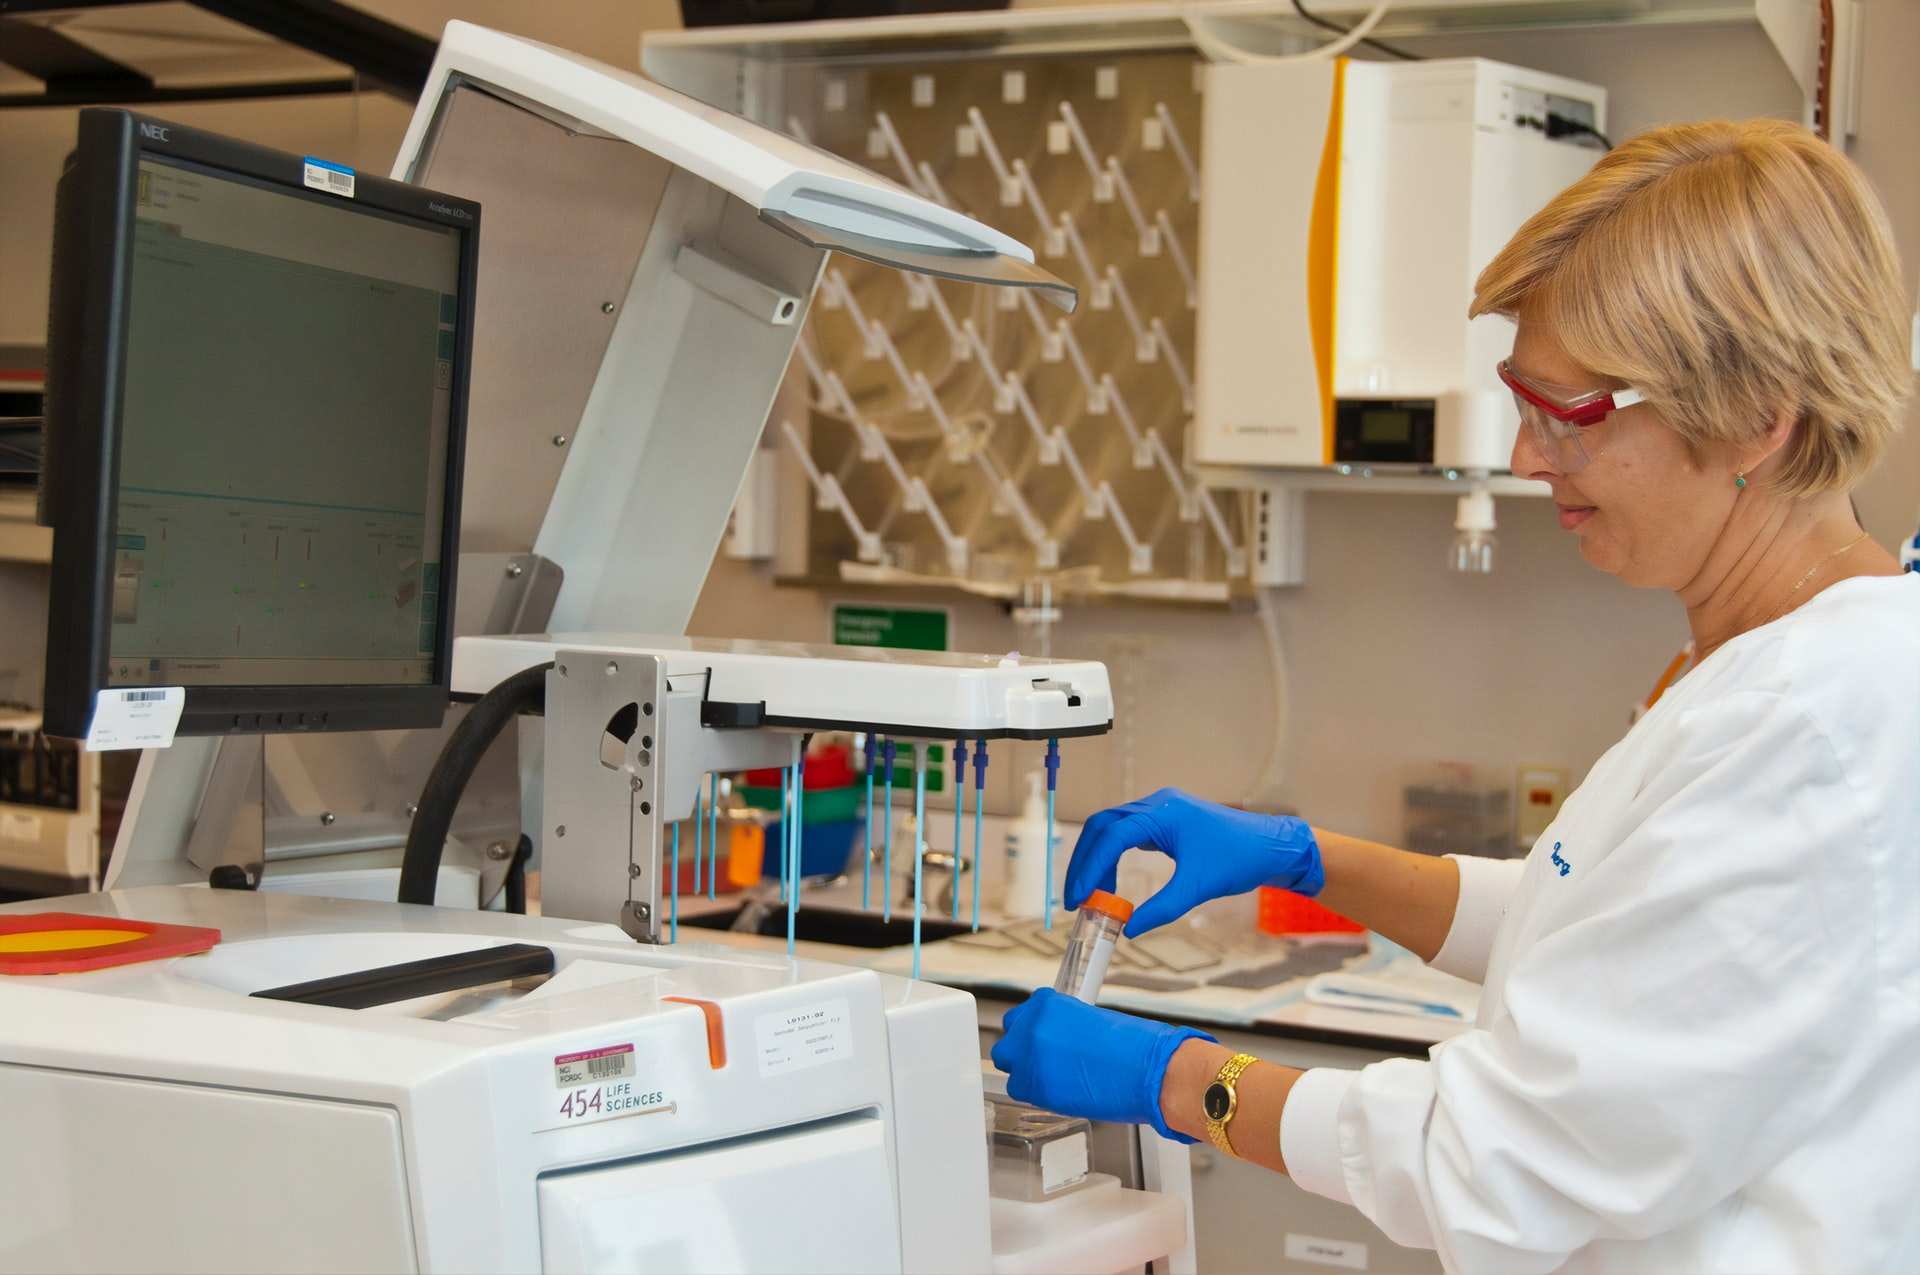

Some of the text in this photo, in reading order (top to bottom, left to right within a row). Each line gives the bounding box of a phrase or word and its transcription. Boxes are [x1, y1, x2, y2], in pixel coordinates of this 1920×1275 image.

[140, 121, 169, 143] NEC
[606, 1083, 631, 1098] LIFE
[560, 1088, 602, 1119] 454
[606, 1091, 663, 1112] SCIENCES
